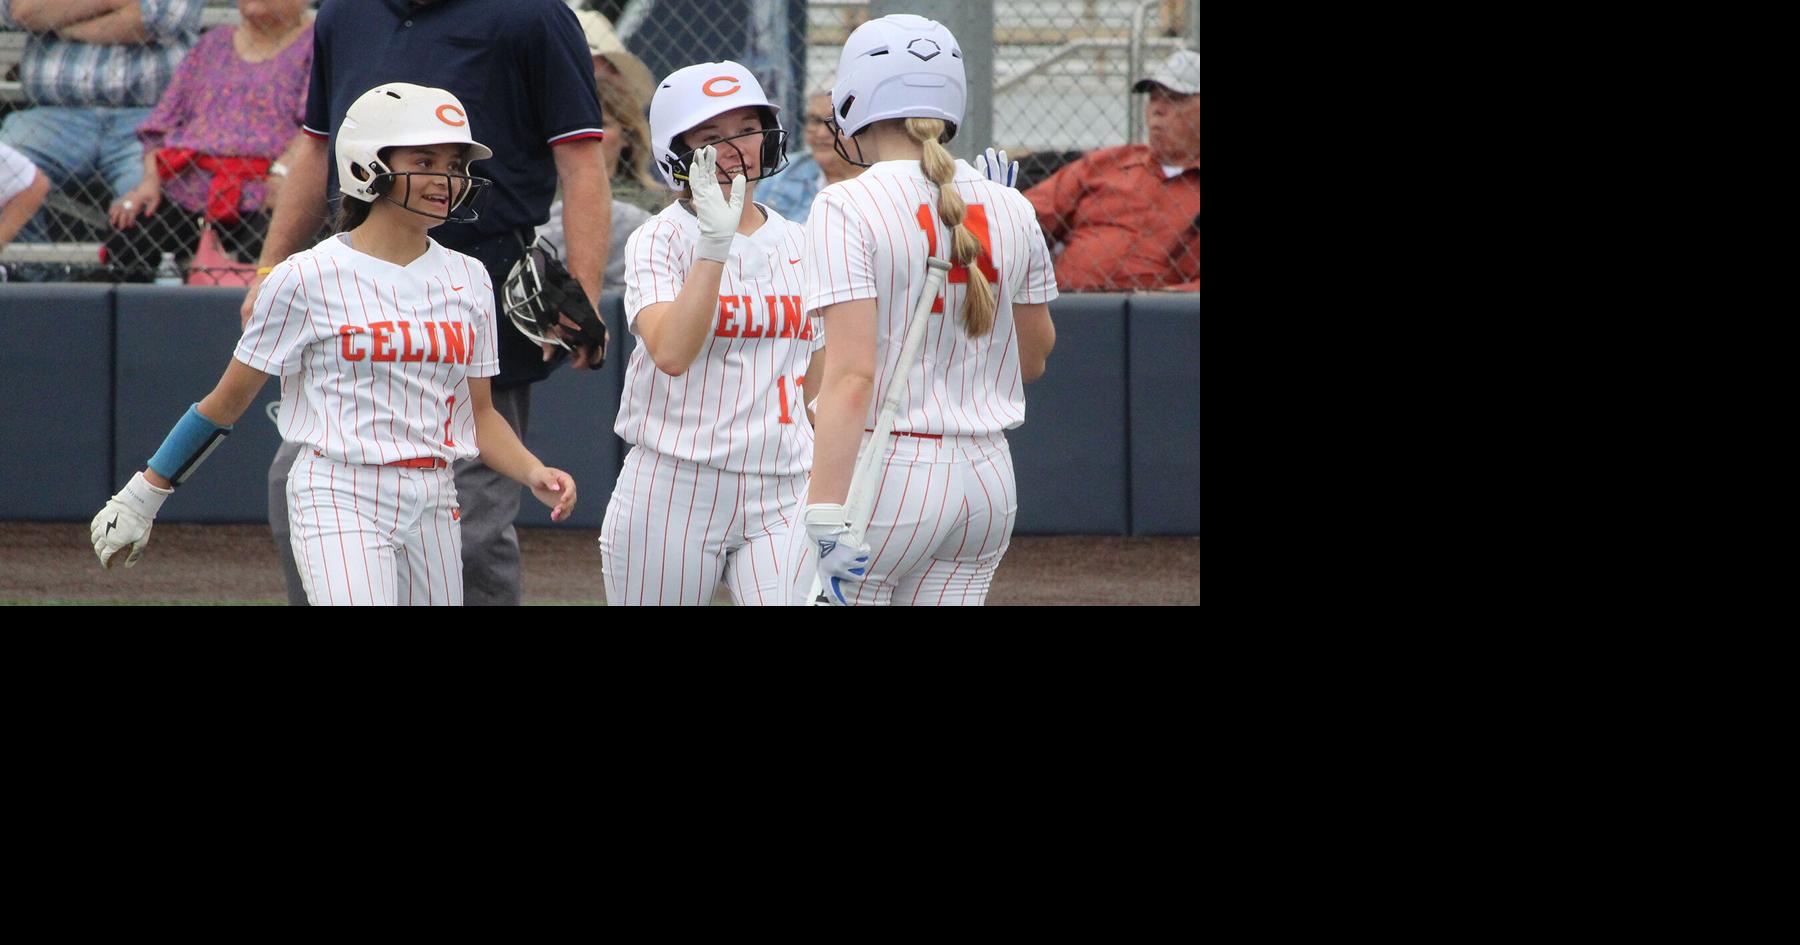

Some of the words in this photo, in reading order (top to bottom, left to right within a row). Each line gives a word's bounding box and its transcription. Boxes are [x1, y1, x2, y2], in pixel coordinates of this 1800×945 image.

[702, 76, 741, 97] C
[435, 104, 465, 127] C
[714, 295, 813, 341] ELINA
